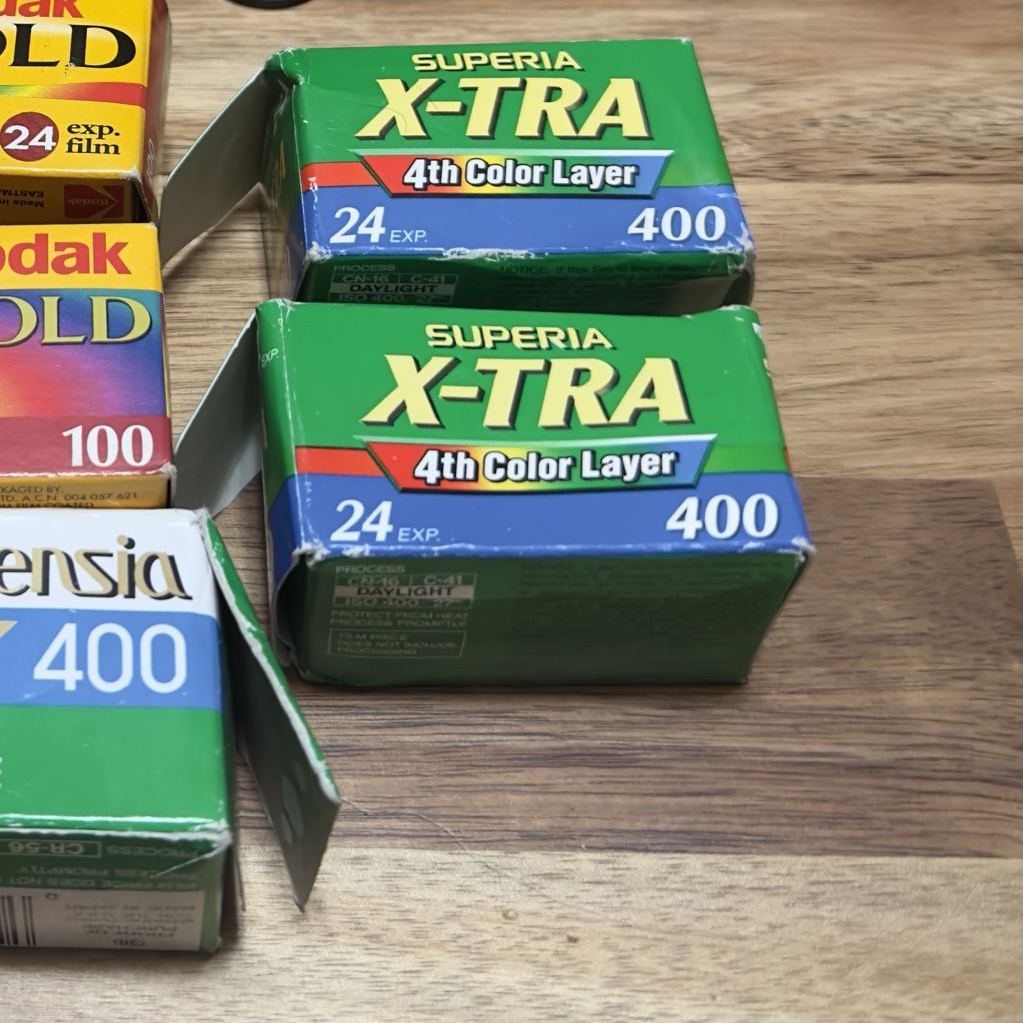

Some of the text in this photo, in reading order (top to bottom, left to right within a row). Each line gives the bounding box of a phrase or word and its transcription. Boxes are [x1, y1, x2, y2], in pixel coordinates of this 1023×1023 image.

[410, 50, 587, 72] SUPERIA
[352, 77, 655, 141] X-TRA
[4, 124, 57, 152] 24
[66, 122, 121, 140] exp.
[65, 137, 121, 156] film
[401, 157, 638, 192] 4th Color Layer
[0, 197, 10, 206] in
[12, 199, 45, 209] Made
[329, 205, 429, 245] 24 EXP.
[627, 205, 727, 242] 400
[332, 264, 396, 272] PROCESS
[349, 283, 438, 293] DAYLIGHT
[424, 323, 616, 351] SUPERIA
[359, 354, 693, 430] X-TRA
[61, 423, 155, 469] 100
[412, 448, 678, 485] 4th Color Layer
[63, 493, 88, 502] 004
[91, 492, 113, 502] 057
[115, 491, 138, 501] 621
[329, 498, 443, 544] 24 EXP.
[665, 492, 781, 541] 400
[335, 564, 407, 574] PROCESS
[356, 586, 454, 597] DAYLIGHT
[32, 621, 188, 693] 400
[7, 840, 85, 855] CR-56
